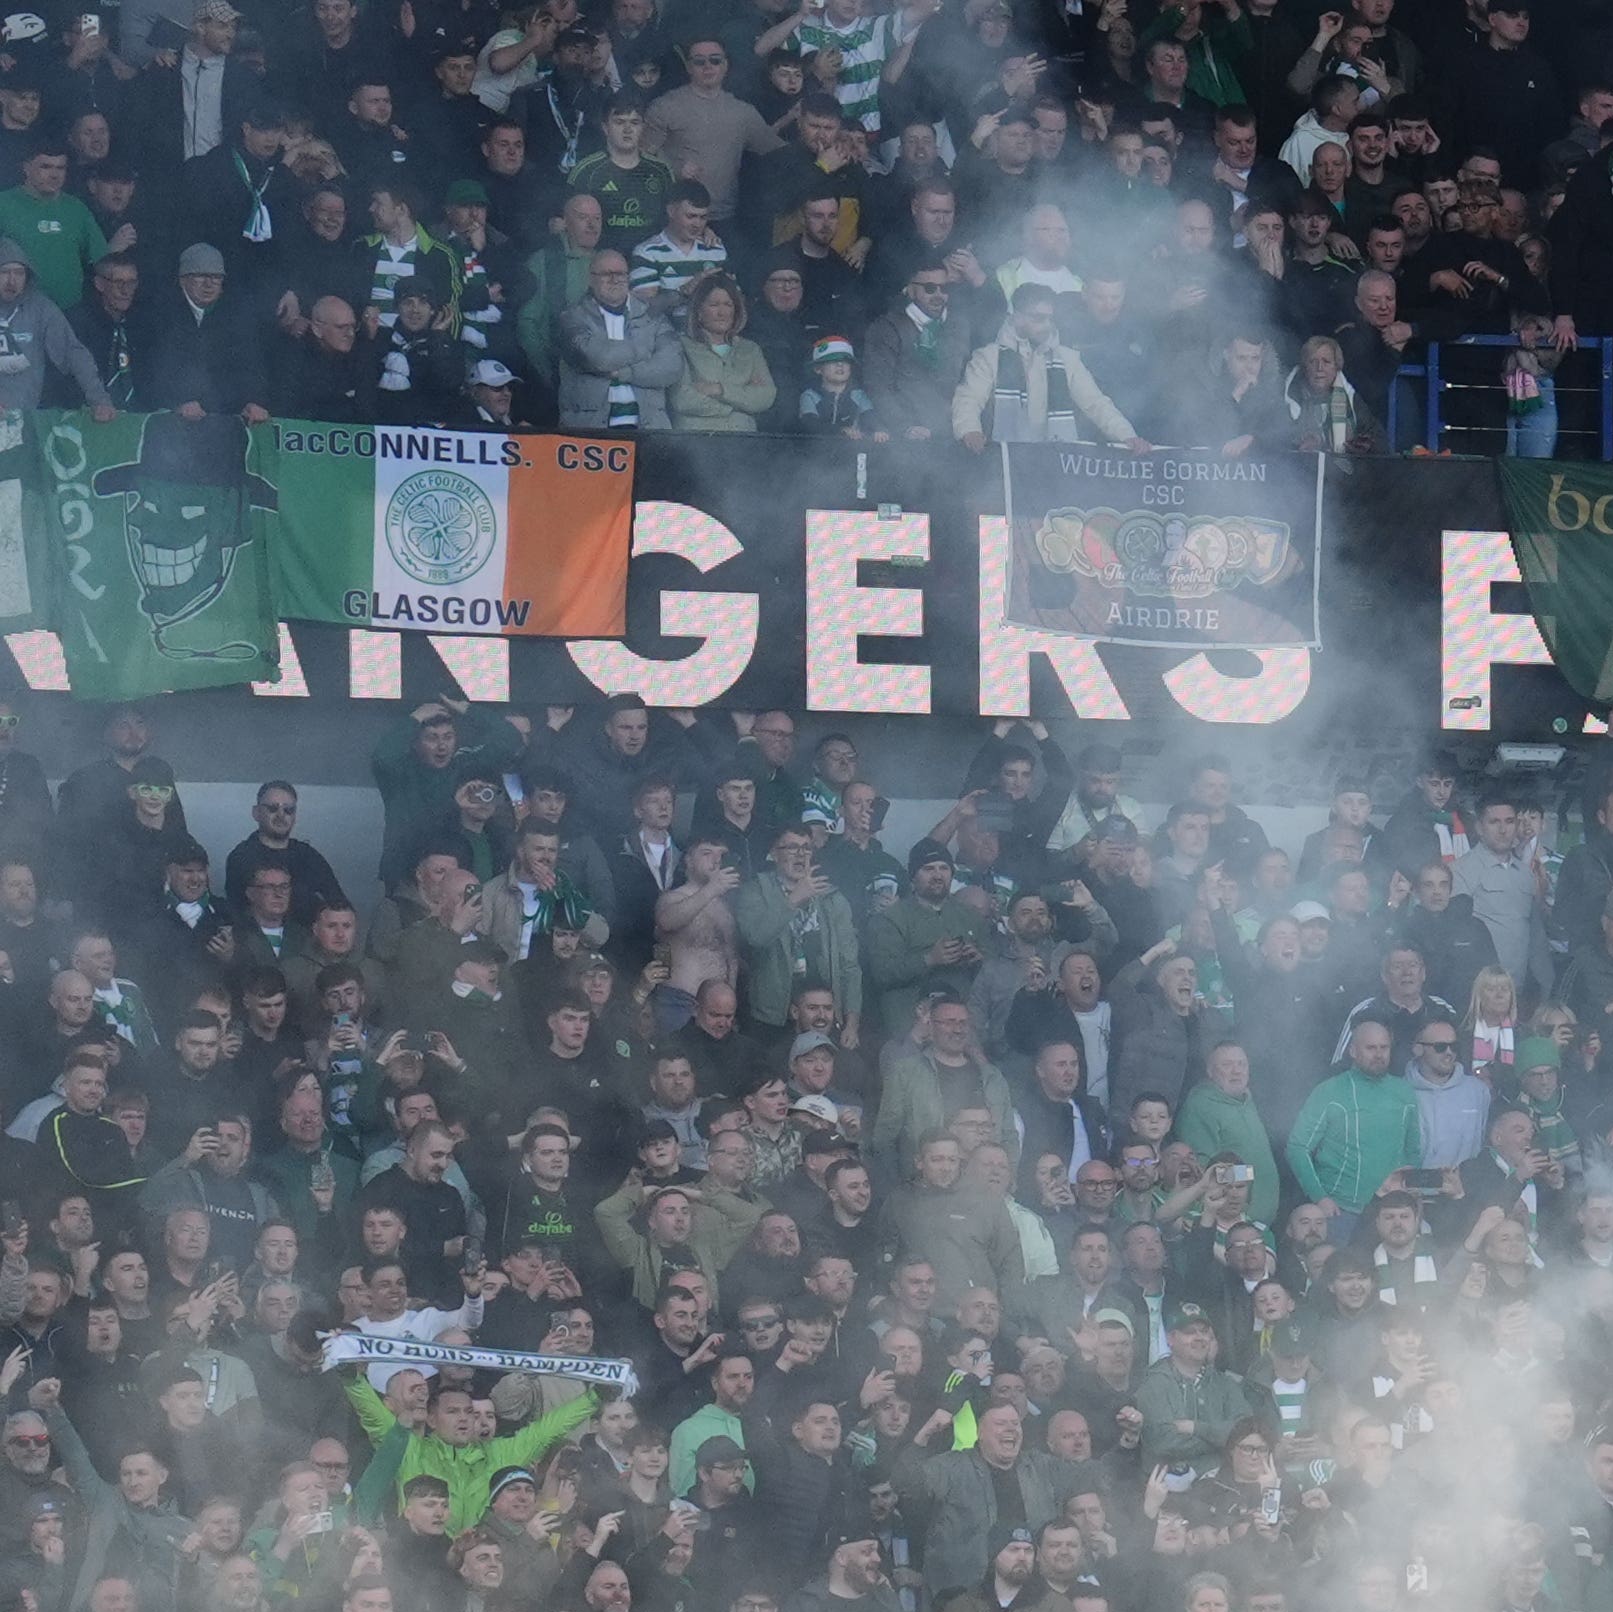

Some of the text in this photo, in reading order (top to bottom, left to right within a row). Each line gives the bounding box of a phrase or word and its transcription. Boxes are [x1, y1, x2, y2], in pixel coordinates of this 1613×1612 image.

[557, 443, 629, 472] CSC
[1059, 452, 1267, 482] WULLIE GORMAN
[396, 478, 427, 507] CELTIC
[428, 475, 480, 504] FOOTBALL
[476, 504, 491, 533] CLUB
[1142, 484, 1185, 505] CSC
[343, 590, 532, 627] GLASGOW
[1106, 602, 1220, 631] AIRDRIE
[357, 1338, 394, 1356] NO
